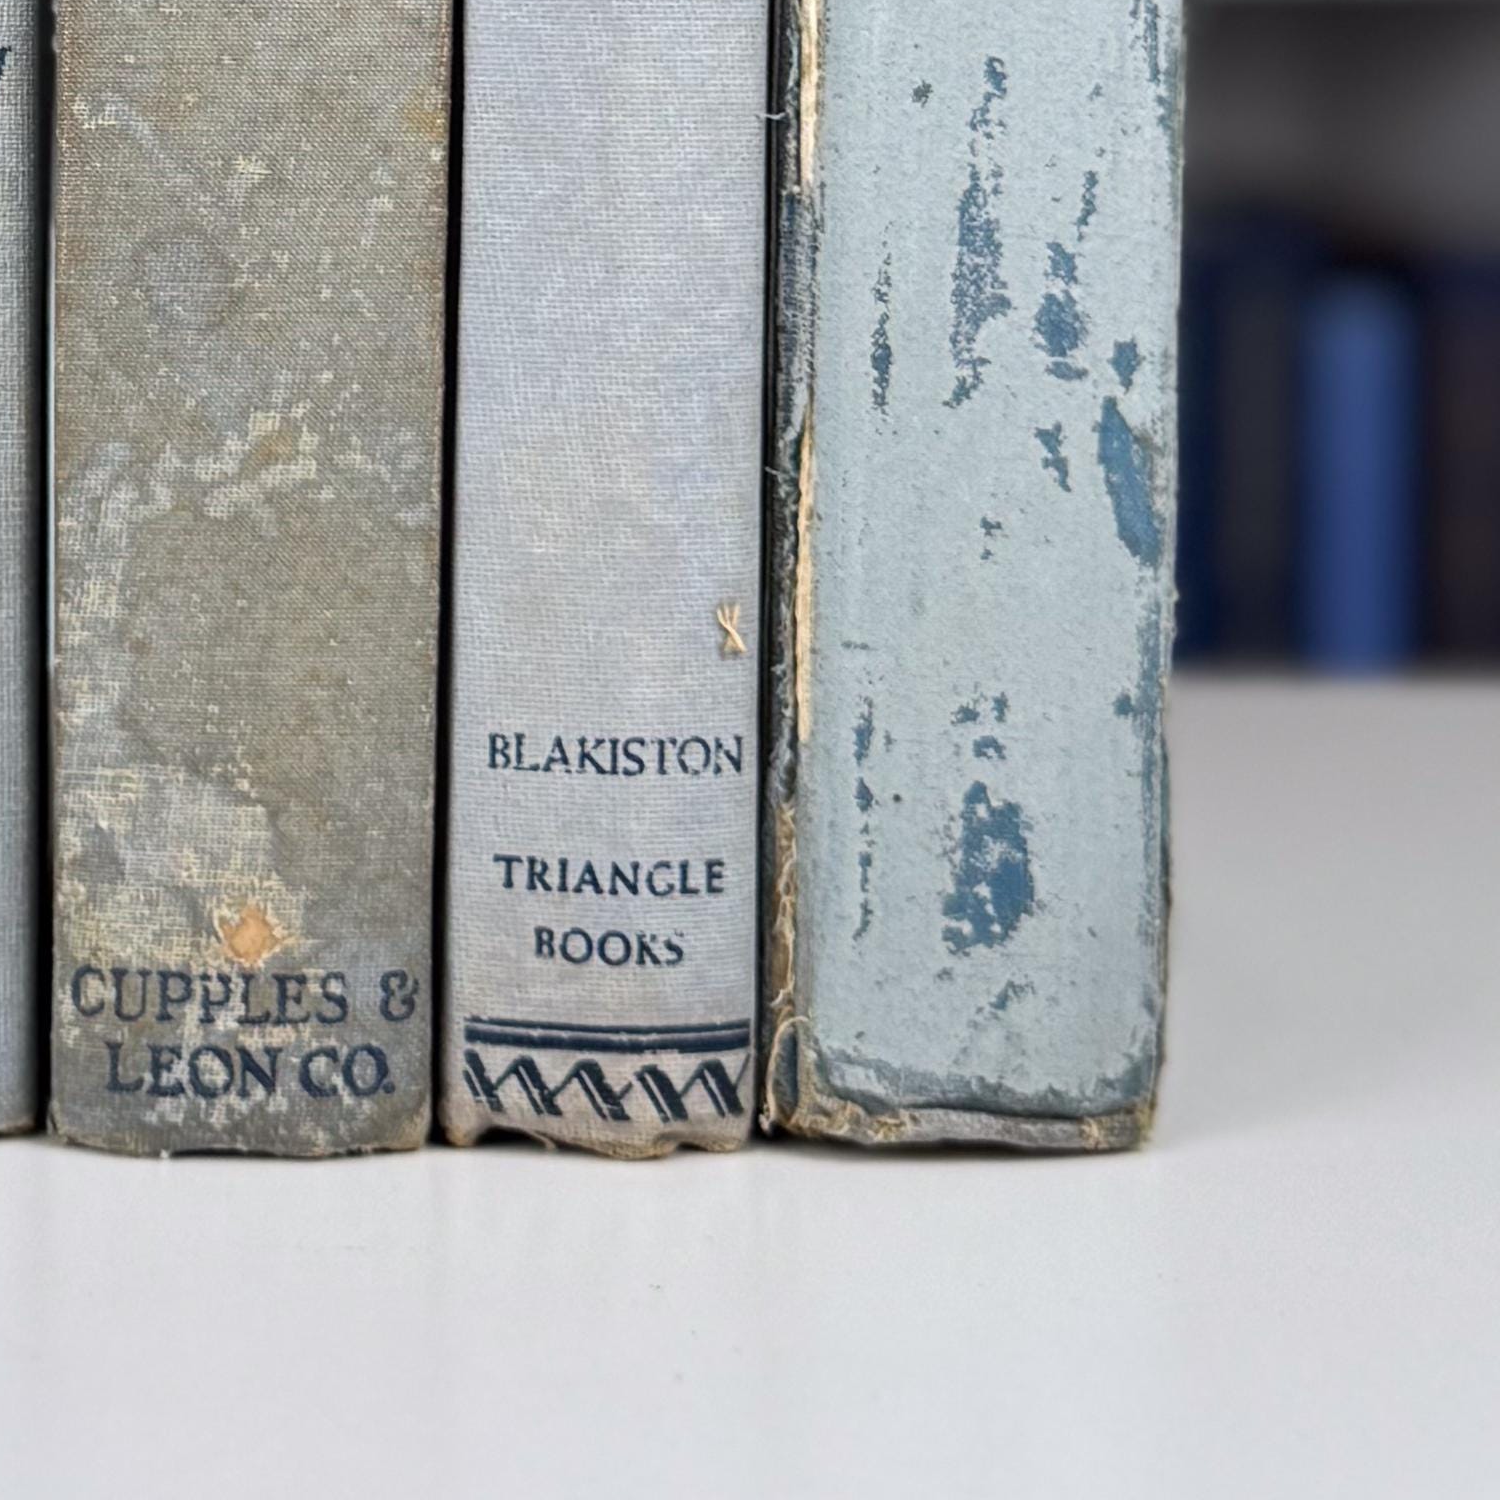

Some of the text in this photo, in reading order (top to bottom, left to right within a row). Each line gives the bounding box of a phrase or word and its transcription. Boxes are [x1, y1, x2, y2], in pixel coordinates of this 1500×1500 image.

[488, 731, 743, 777] BLAKISTON
[493, 853, 725, 897] TRIANGLE
[534, 926, 684, 967] BOOKS
[71, 964, 419, 1024] CUPPLES &
[105, 1041, 396, 1098] LEON CO.
